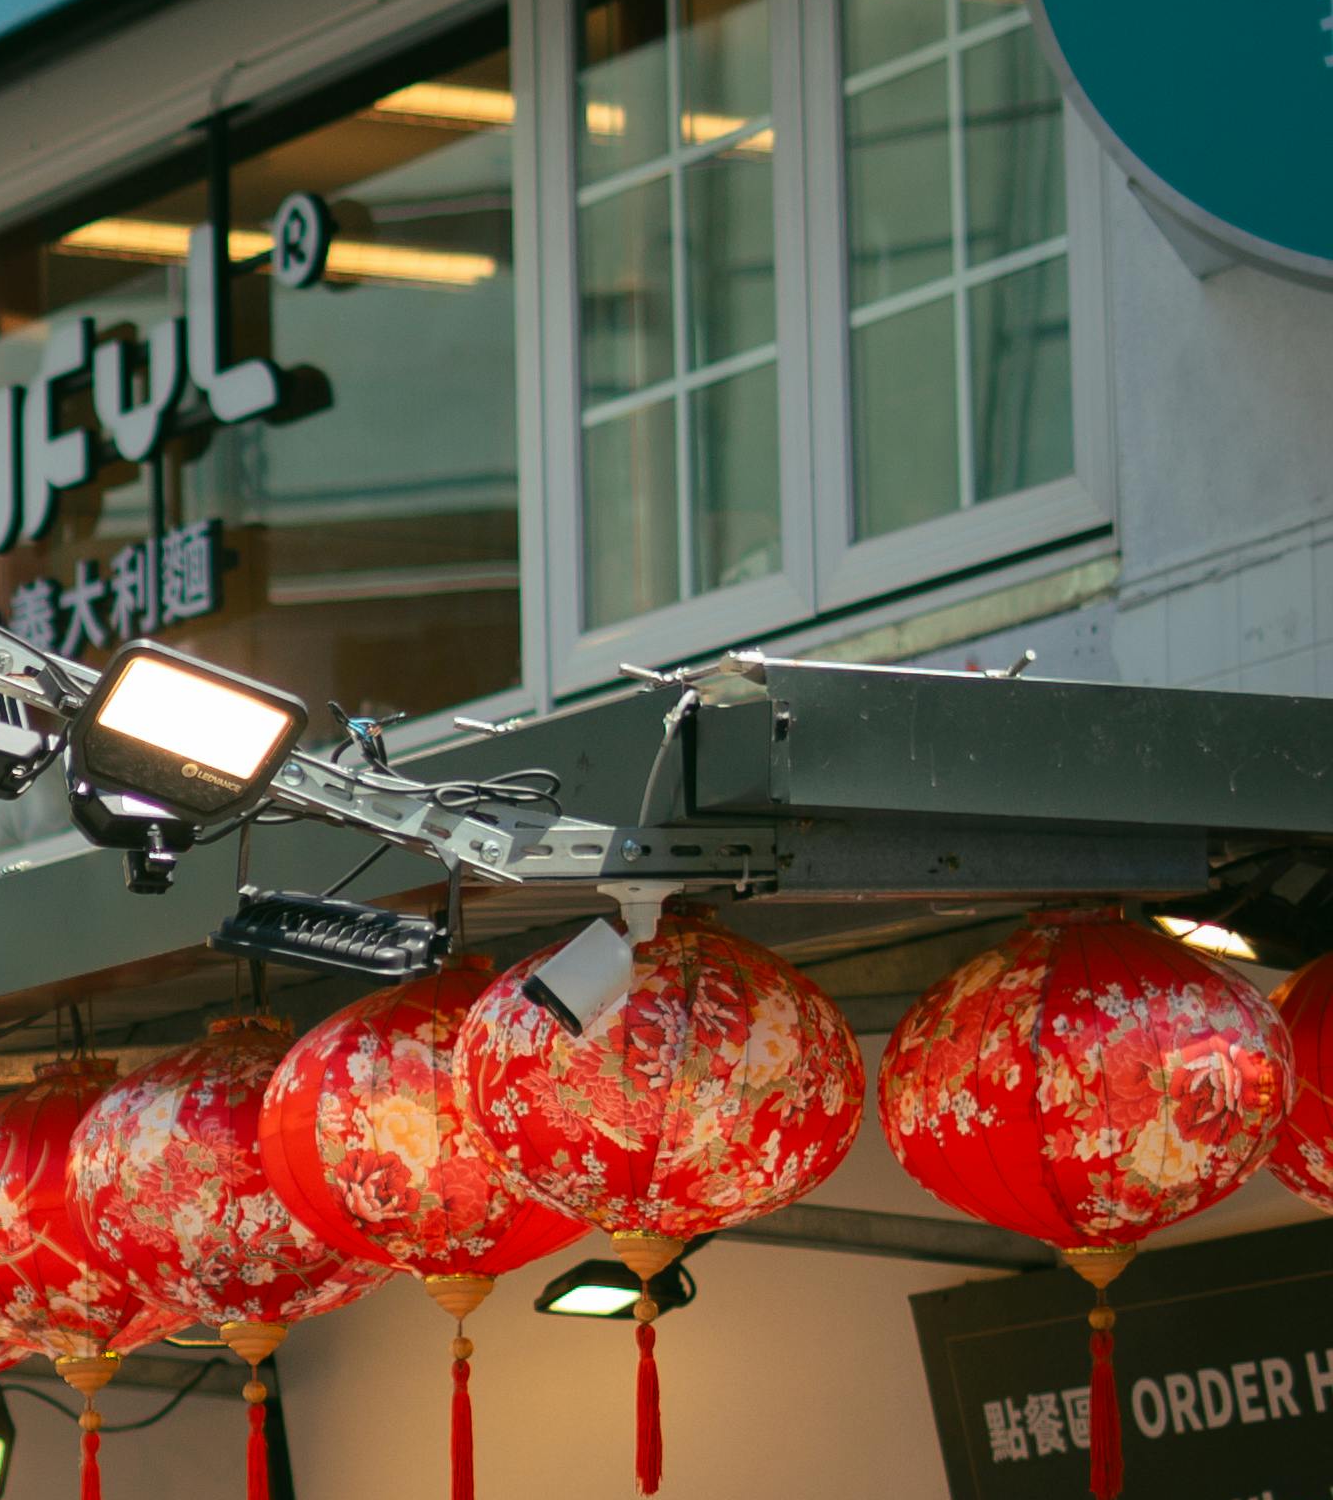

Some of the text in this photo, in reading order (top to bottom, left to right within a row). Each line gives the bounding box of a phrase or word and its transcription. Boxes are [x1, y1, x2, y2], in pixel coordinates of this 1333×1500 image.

[197, 769, 242, 794] LEDVANCE
[1132, 1357, 1301, 1439] ORDER
[1305, 1348, 1333, 1414] H
